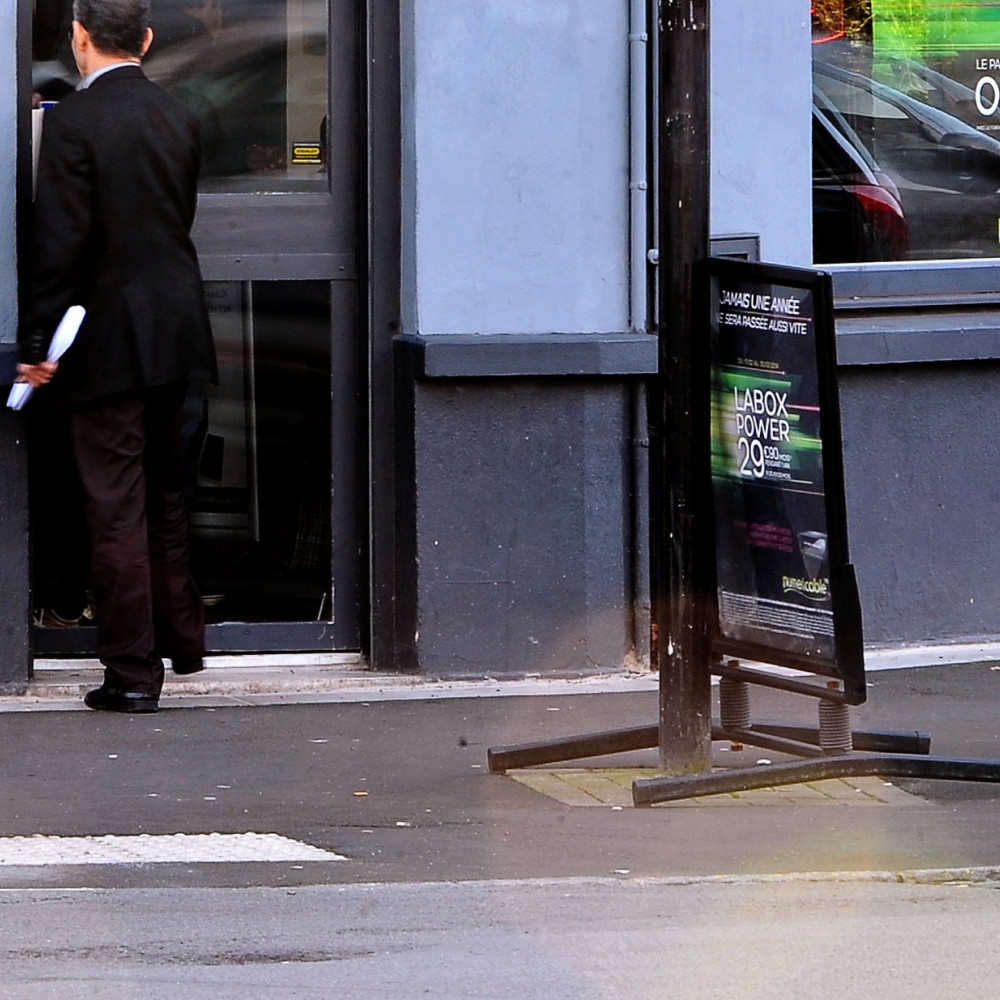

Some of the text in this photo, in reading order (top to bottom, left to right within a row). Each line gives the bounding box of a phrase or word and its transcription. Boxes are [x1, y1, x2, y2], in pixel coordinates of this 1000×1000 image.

[976, 58, 988, 70] LE
[720, 290, 800, 315] JAMAIS UNE ANNÉE
[725, 314, 741, 326] SERA
[741, 315, 768, 330] PASSÉE
[769, 320, 788, 333] AUSSI
[788, 322, 807, 335] VITE
[736, 413, 790, 442] POWER
[738, 437, 765, 478] 29
[782, 576, 827, 594] numericable
